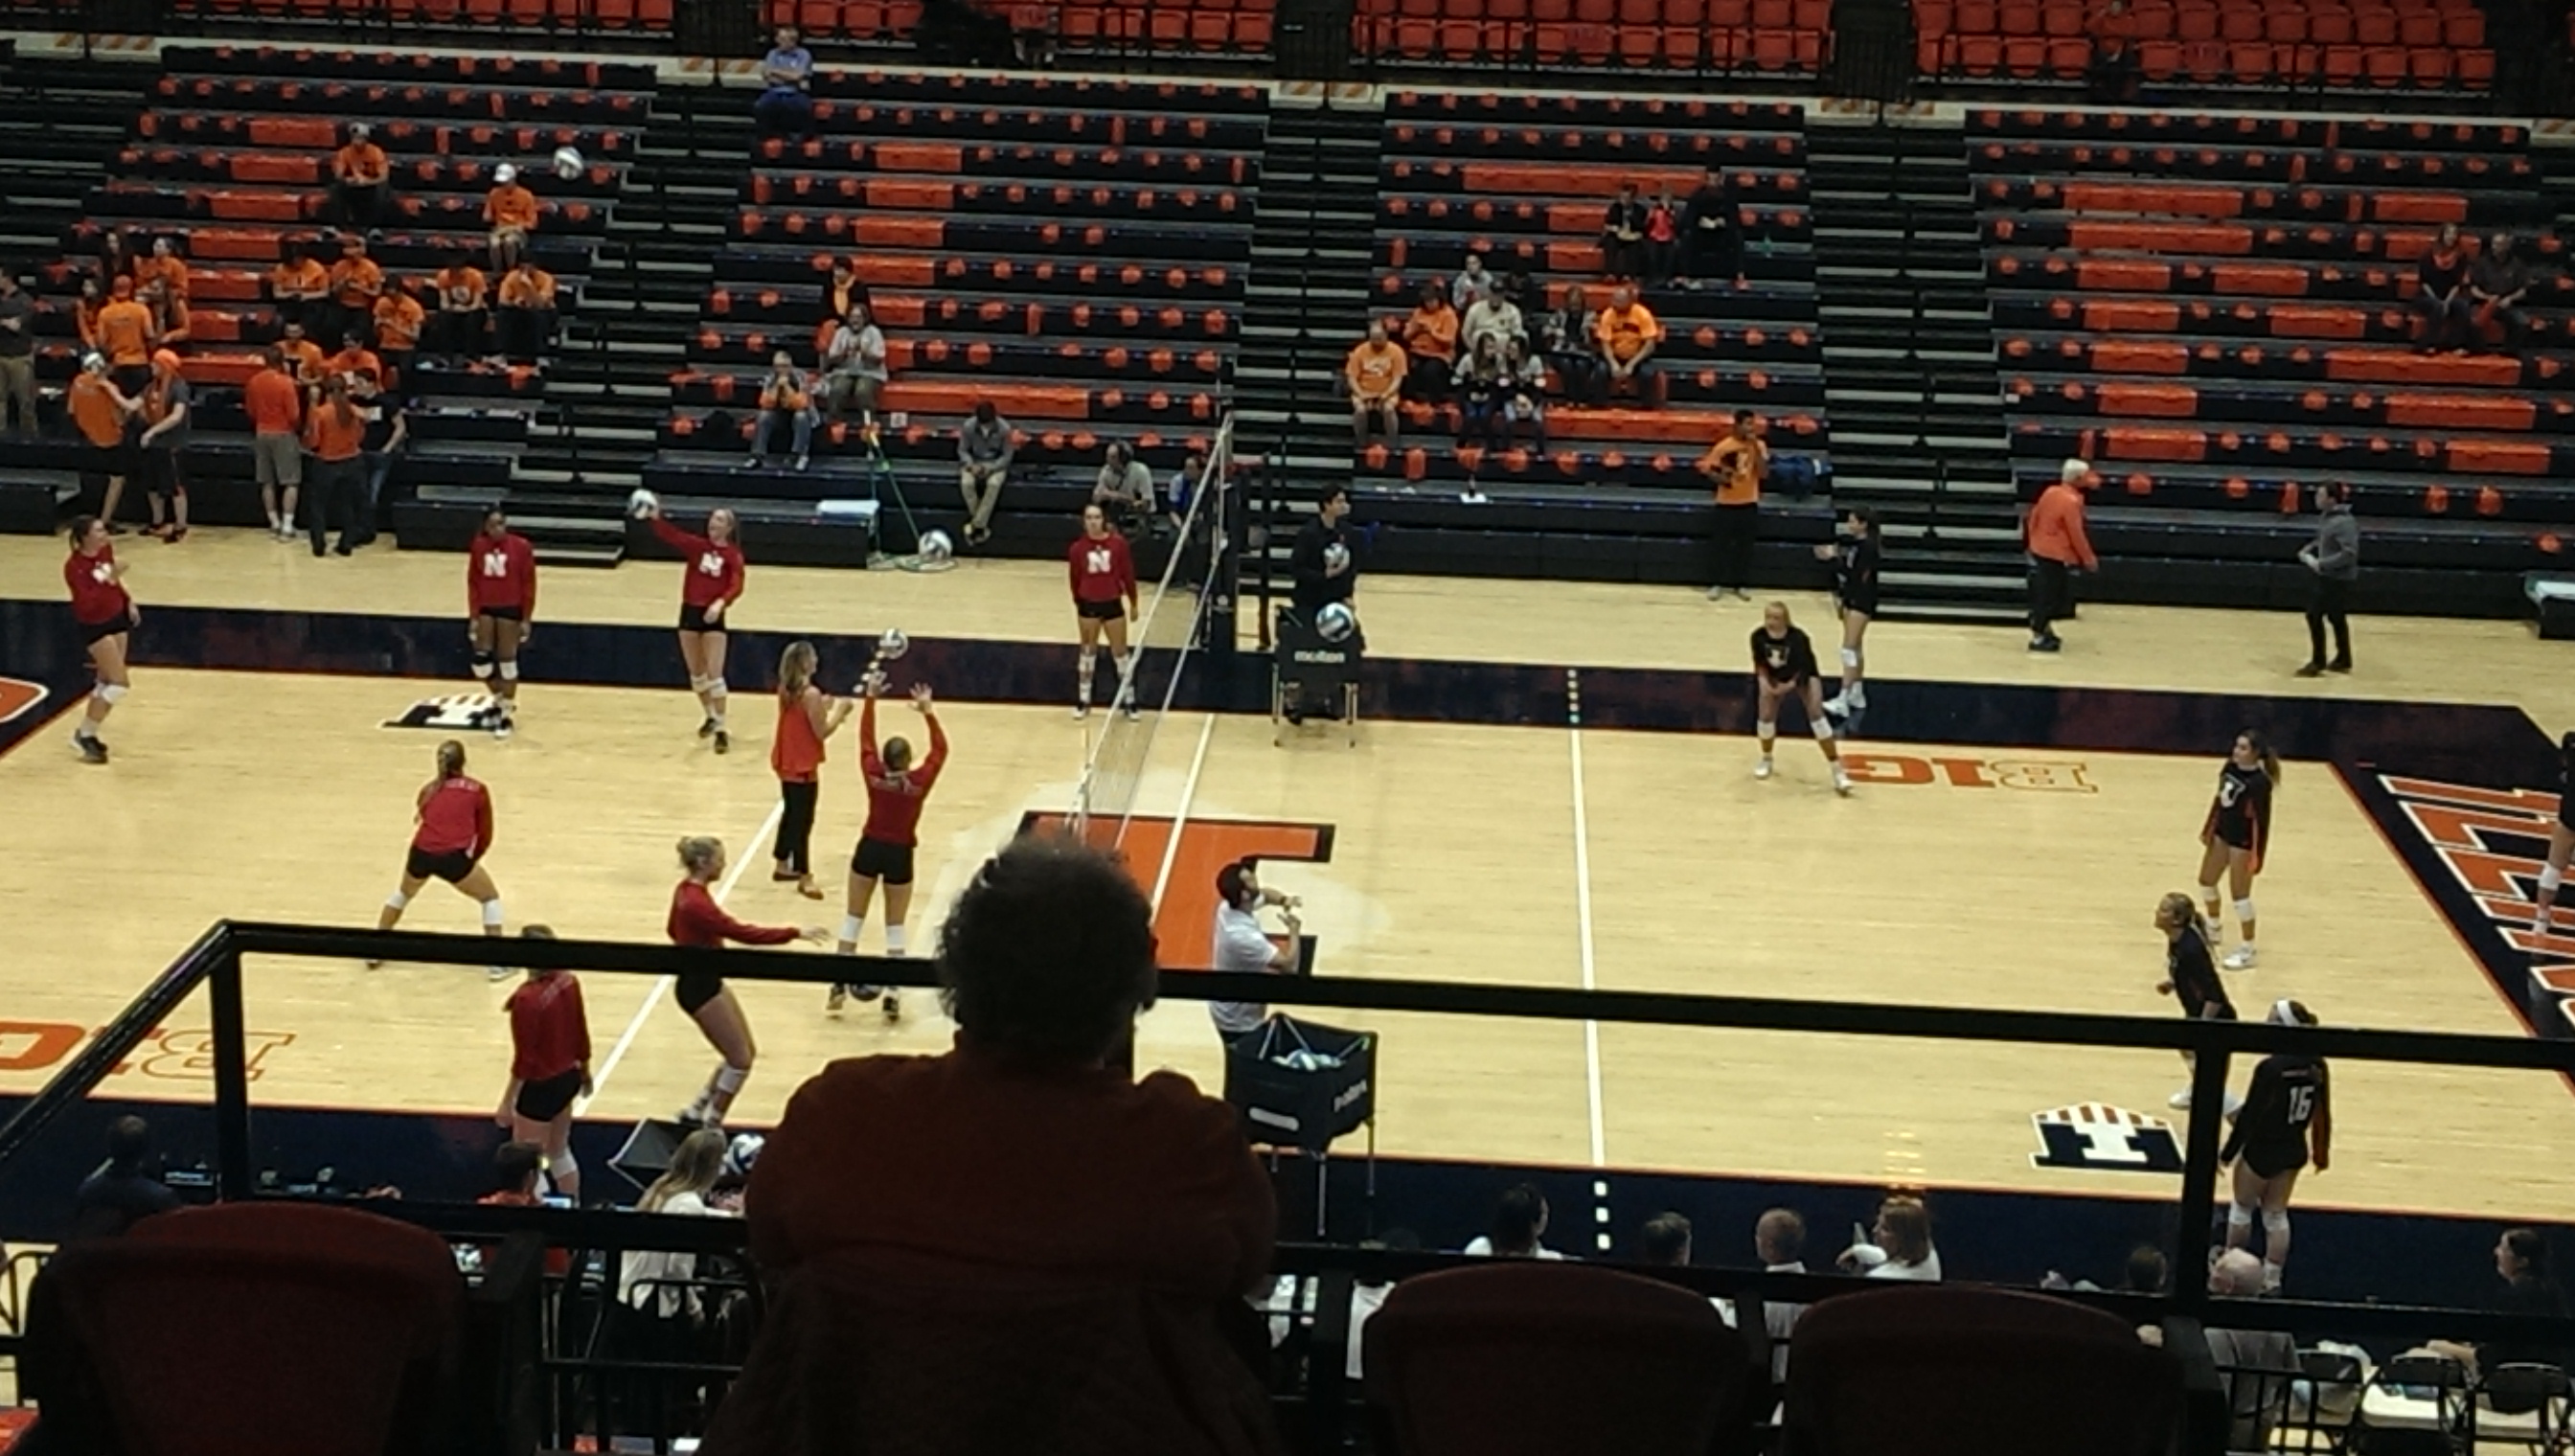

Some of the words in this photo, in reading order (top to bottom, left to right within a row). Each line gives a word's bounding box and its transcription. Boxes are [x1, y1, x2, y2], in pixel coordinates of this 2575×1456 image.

[484, 554, 508, 577] N
[1087, 550, 1111, 574] N
[2288, 1085, 2315, 1125] 16
